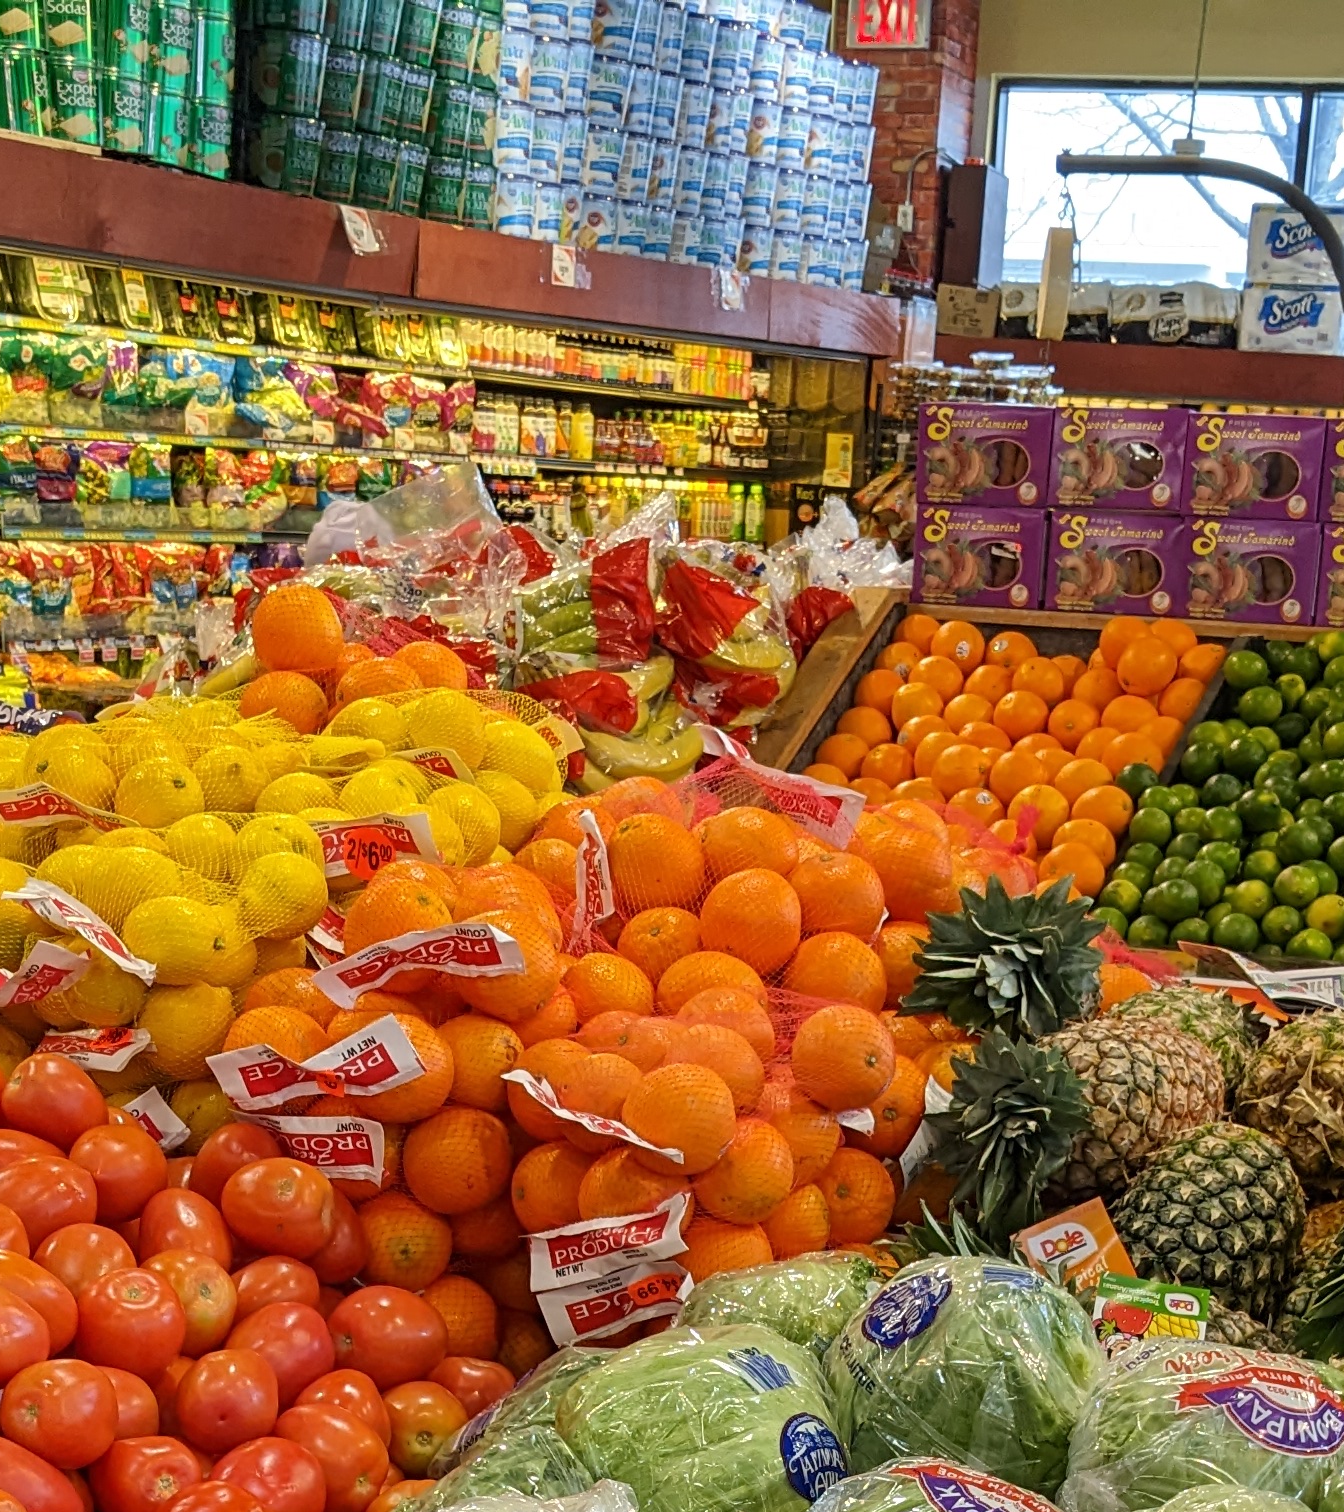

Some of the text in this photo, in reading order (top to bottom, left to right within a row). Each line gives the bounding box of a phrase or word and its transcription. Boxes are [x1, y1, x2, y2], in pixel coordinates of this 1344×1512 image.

[857, 0, 916, 43] EXIT
[1264, 295, 1313, 327] Scott
[927, 407, 1028, 440] Sweet Tamarind
[555, 1225, 660, 1265] PRODUCE
[1040, 1229, 1085, 1258] Dole
